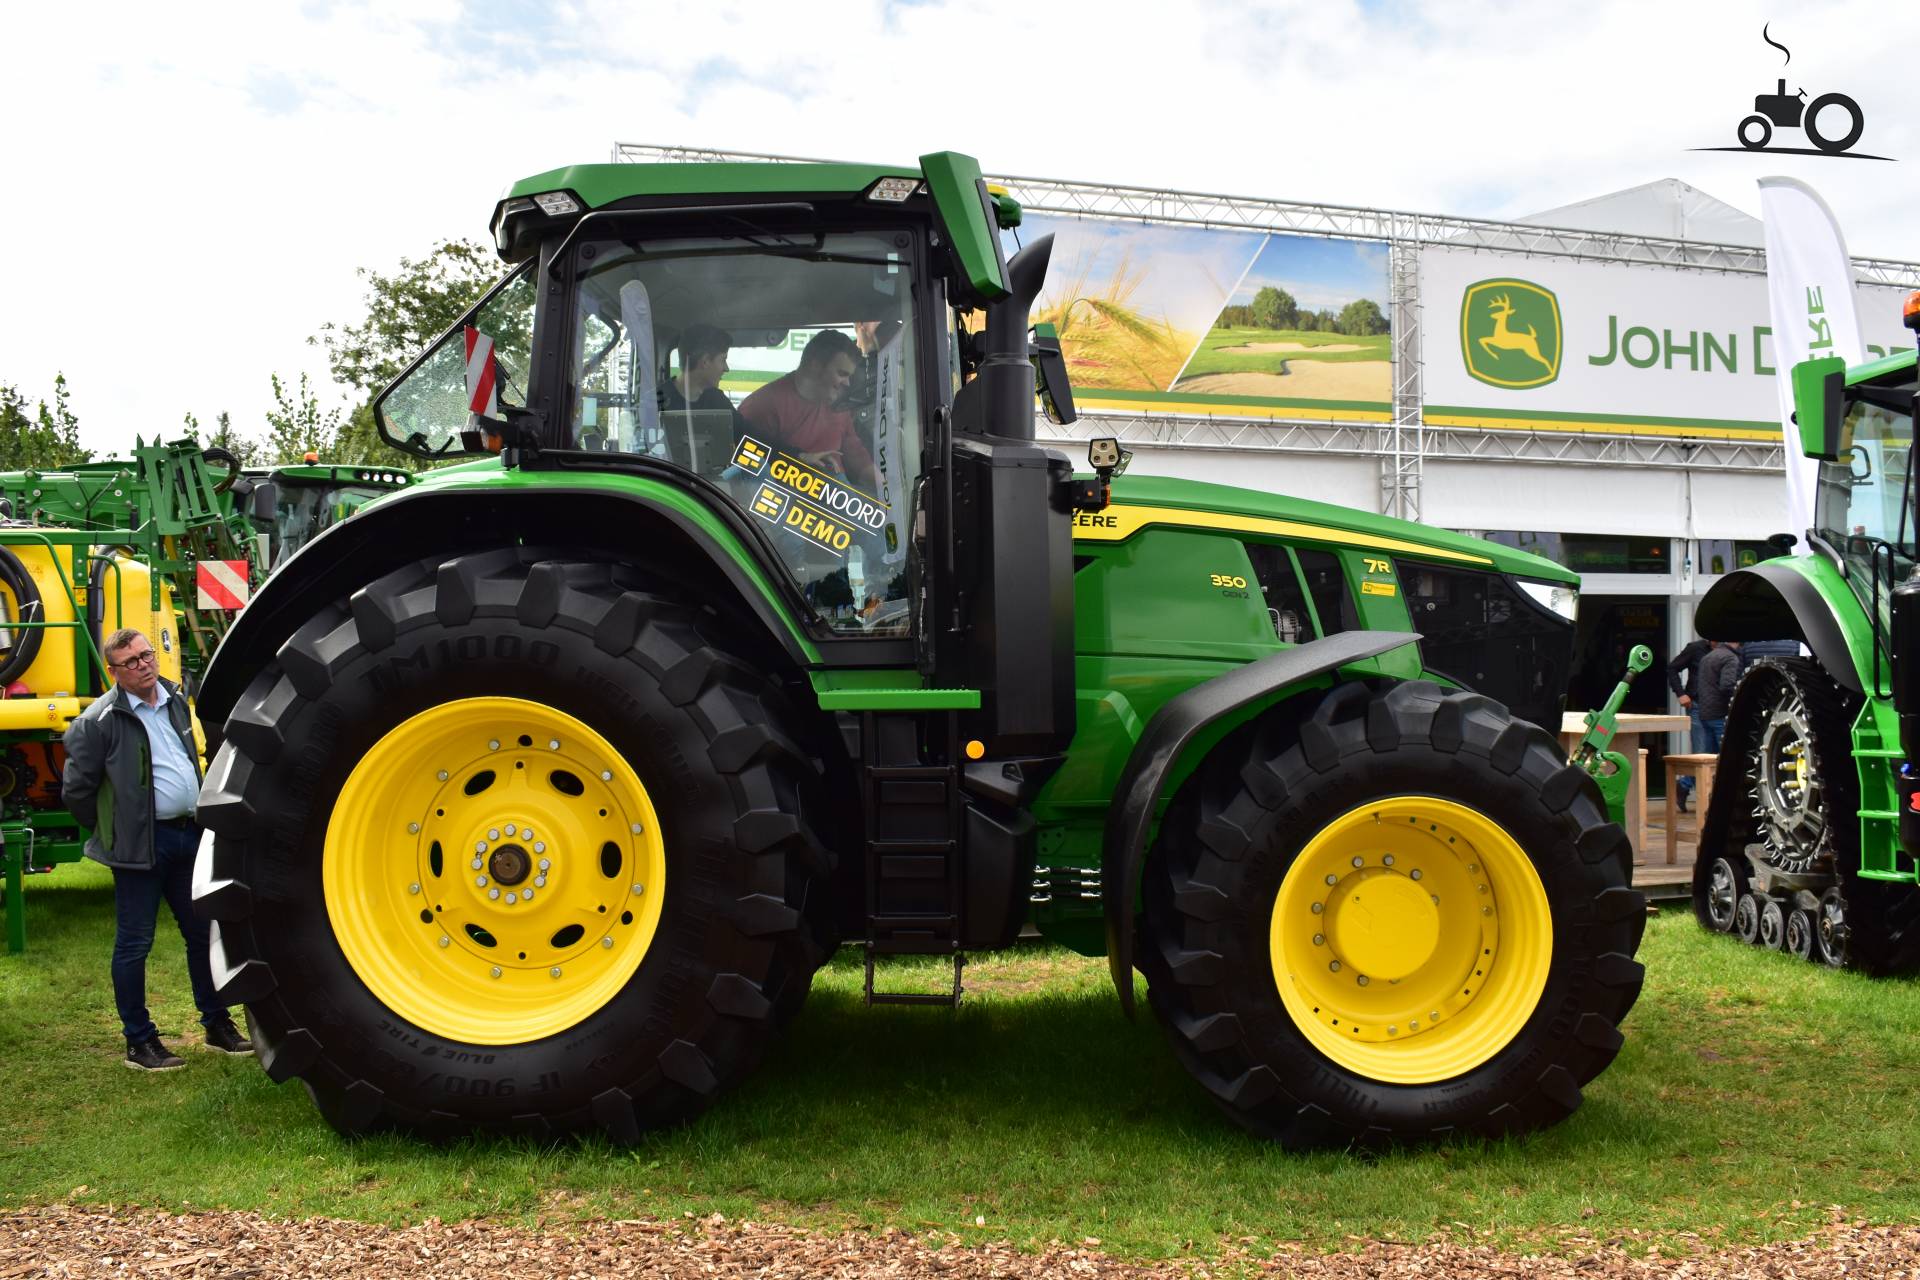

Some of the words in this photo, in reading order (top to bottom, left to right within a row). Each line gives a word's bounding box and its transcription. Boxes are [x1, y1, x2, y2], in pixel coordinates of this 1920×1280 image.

[1588, 315, 1737, 374] JOHN
[769, 459, 886, 529] GROENOORD
[785, 505, 851, 550] DEMO
[1210, 574, 1248, 589] 350
[1362, 558, 1391, 574] 7R
[356, 634, 561, 696] TM1000
[375, 1018, 421, 1049] TIRE
[442, 1049, 497, 1065] BLUE
